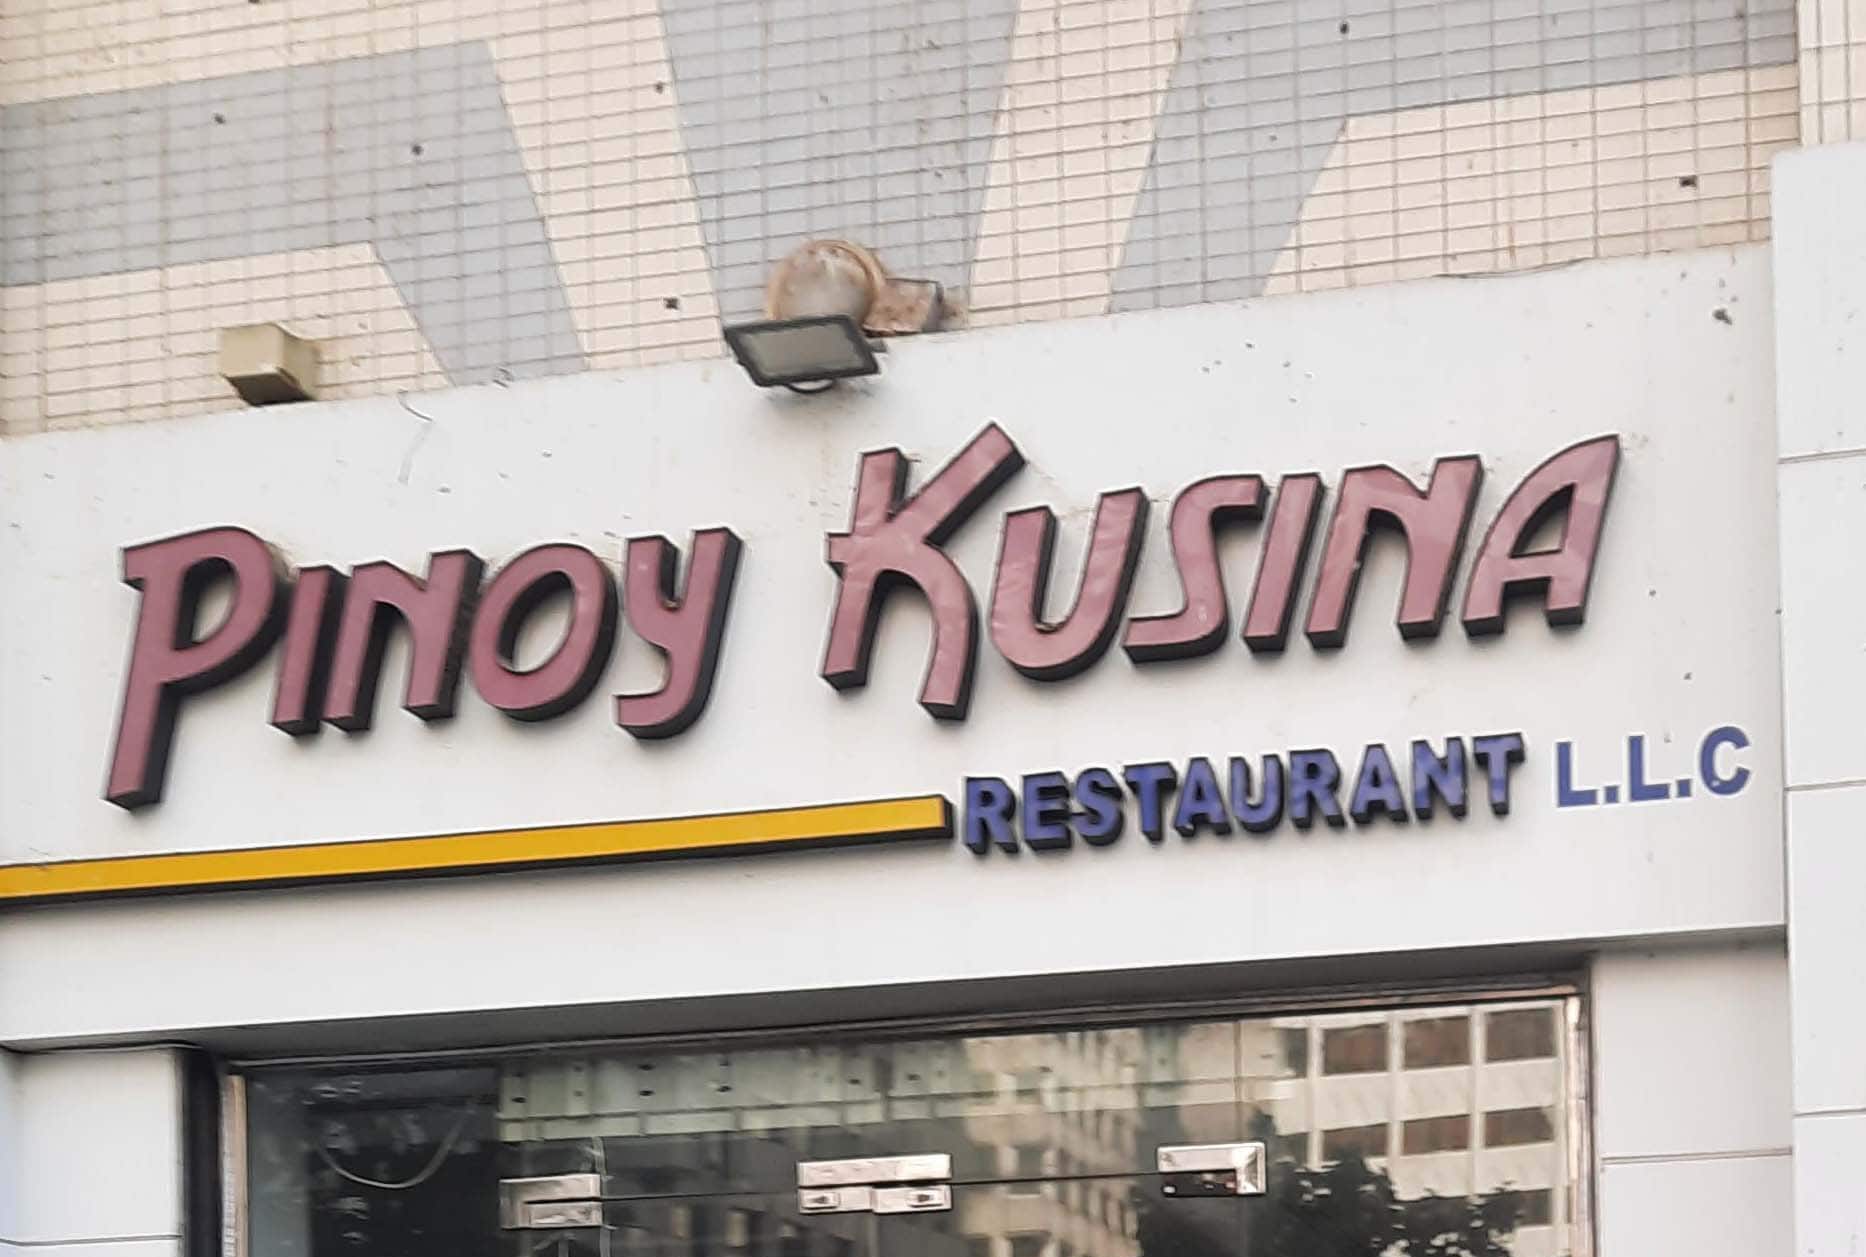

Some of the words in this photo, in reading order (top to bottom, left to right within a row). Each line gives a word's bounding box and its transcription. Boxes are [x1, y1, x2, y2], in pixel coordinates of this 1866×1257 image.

[823, 421, 1621, 721] KUSINA
[963, 732, 1525, 854] RESTAURANT
[1555, 725, 1752, 808] L.L.C
